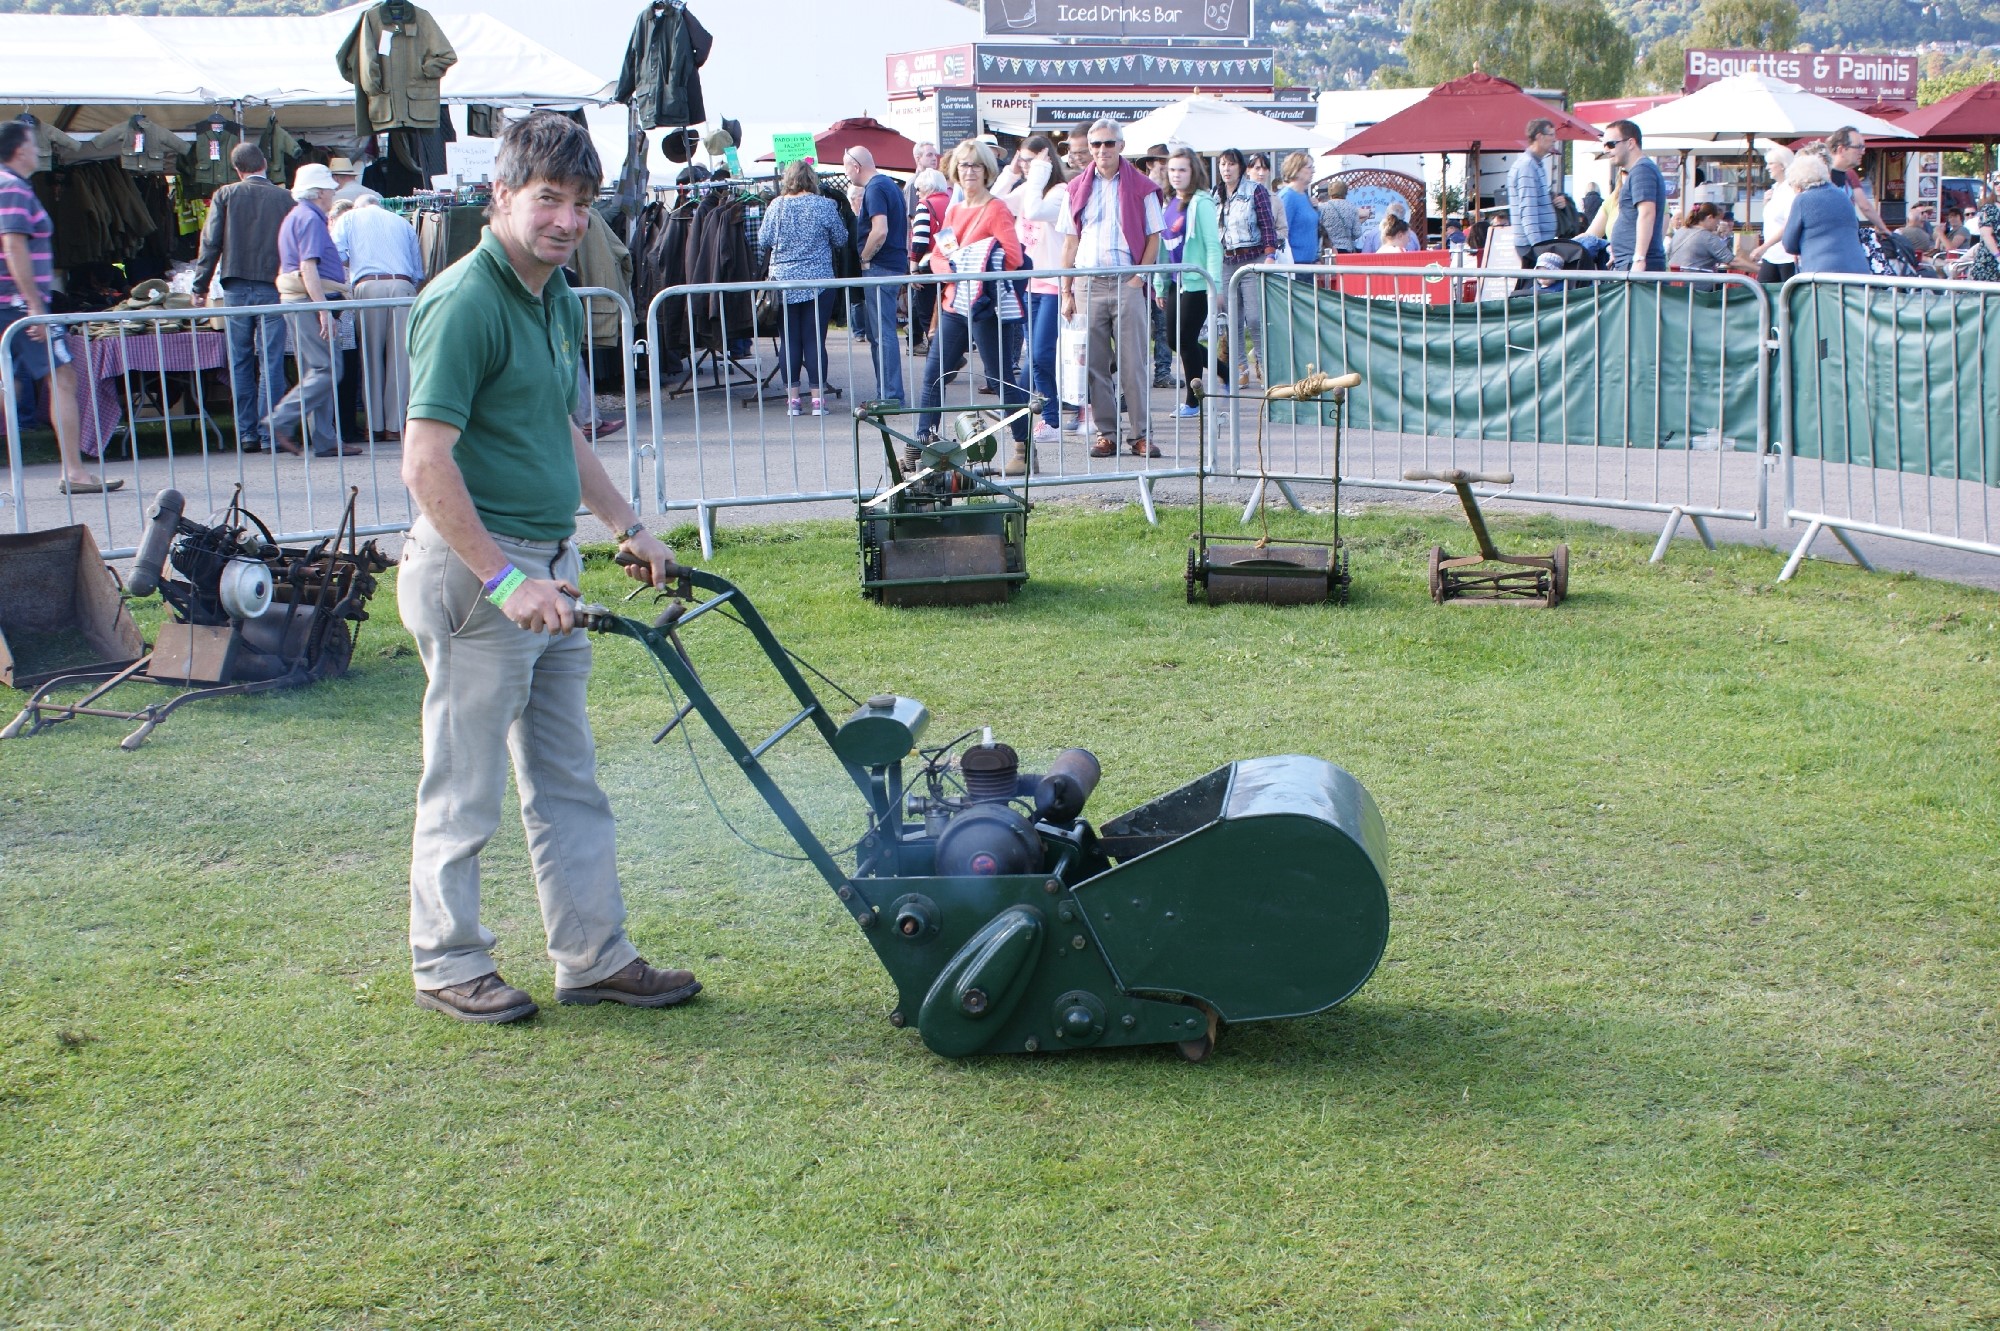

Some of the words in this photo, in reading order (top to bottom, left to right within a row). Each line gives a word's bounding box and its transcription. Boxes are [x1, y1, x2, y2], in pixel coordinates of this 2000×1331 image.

[1058, 5, 1097, 21] Iced
[1101, 5, 1151, 22] Drinks
[1155, 6, 1182, 22] Bar
[1690, 51, 1800, 77] Baguettes
[1813, 56, 1830, 79] &
[1839, 57, 1909, 81] Paninis
[1051, 110, 1066, 119] We
[1068, 110, 1091, 119] make
[1132, 110, 1151, 119] 100
